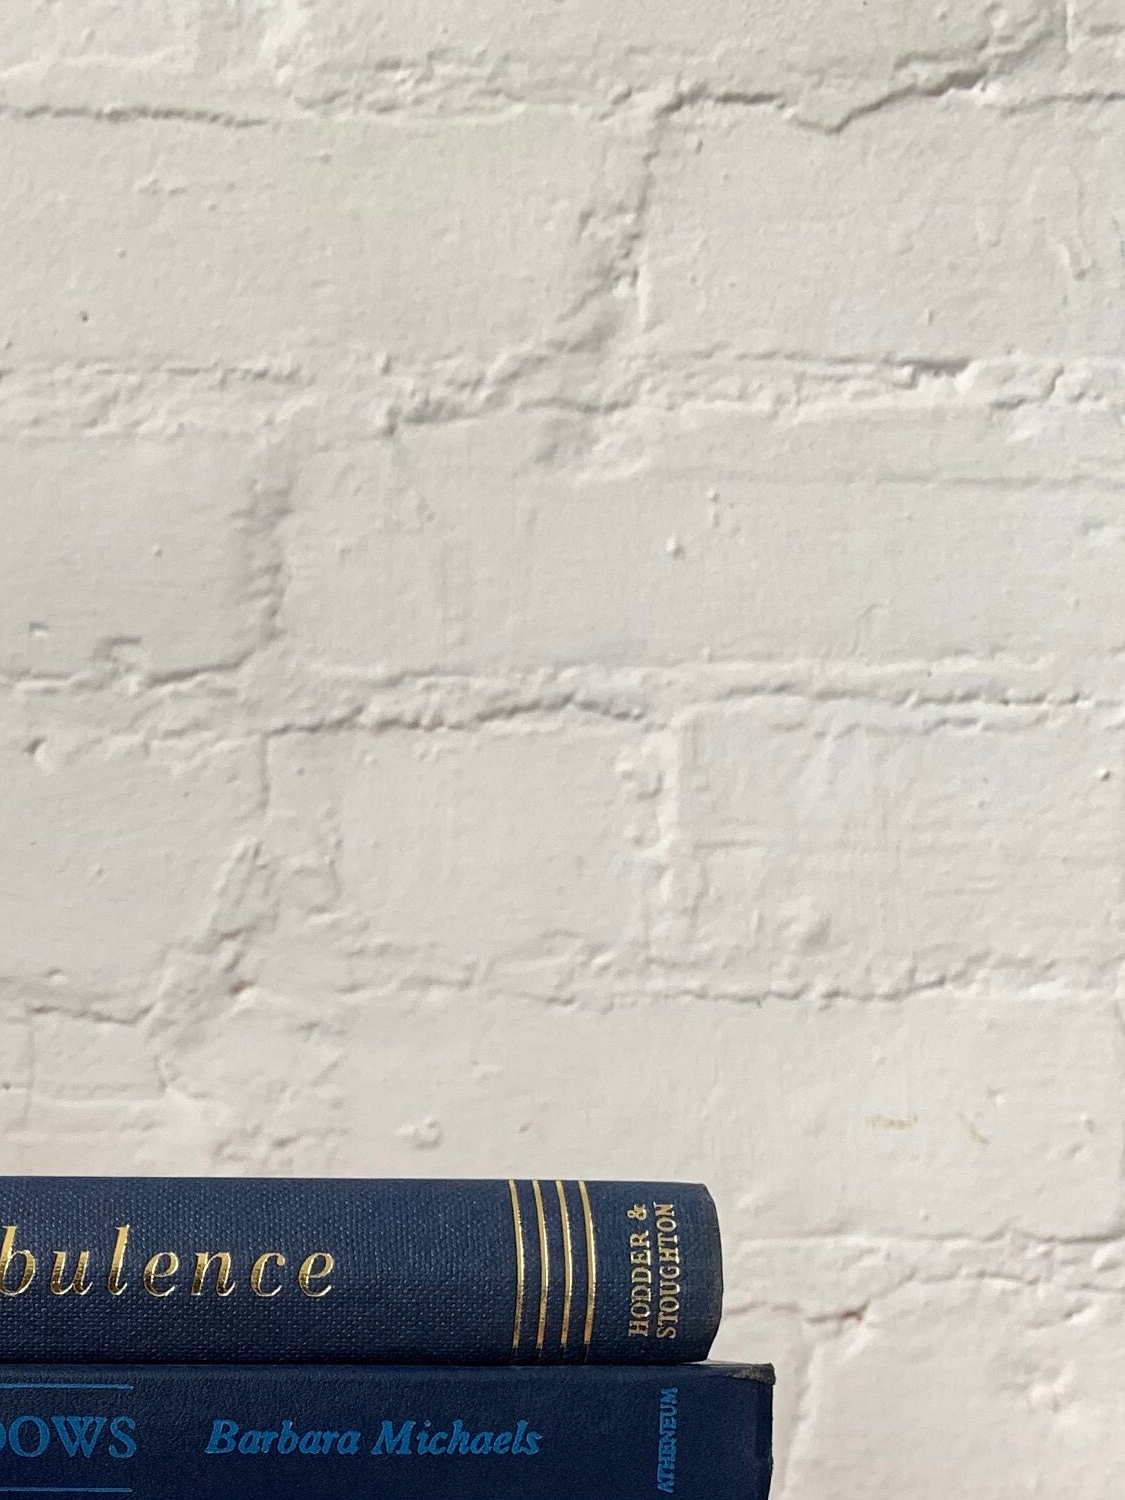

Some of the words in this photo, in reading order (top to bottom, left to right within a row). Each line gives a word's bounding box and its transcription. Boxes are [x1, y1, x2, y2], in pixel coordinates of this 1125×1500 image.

[627, 1203, 649, 1221] &
[628, 1234, 650, 1338] HODDER
[653, 1202, 680, 1340] STOUGHTON
[205, 1419, 359, 1455] Barbara
[371, 1419, 543, 1457] Michaels
[656, 1388, 679, 1494] ATHENEUM
